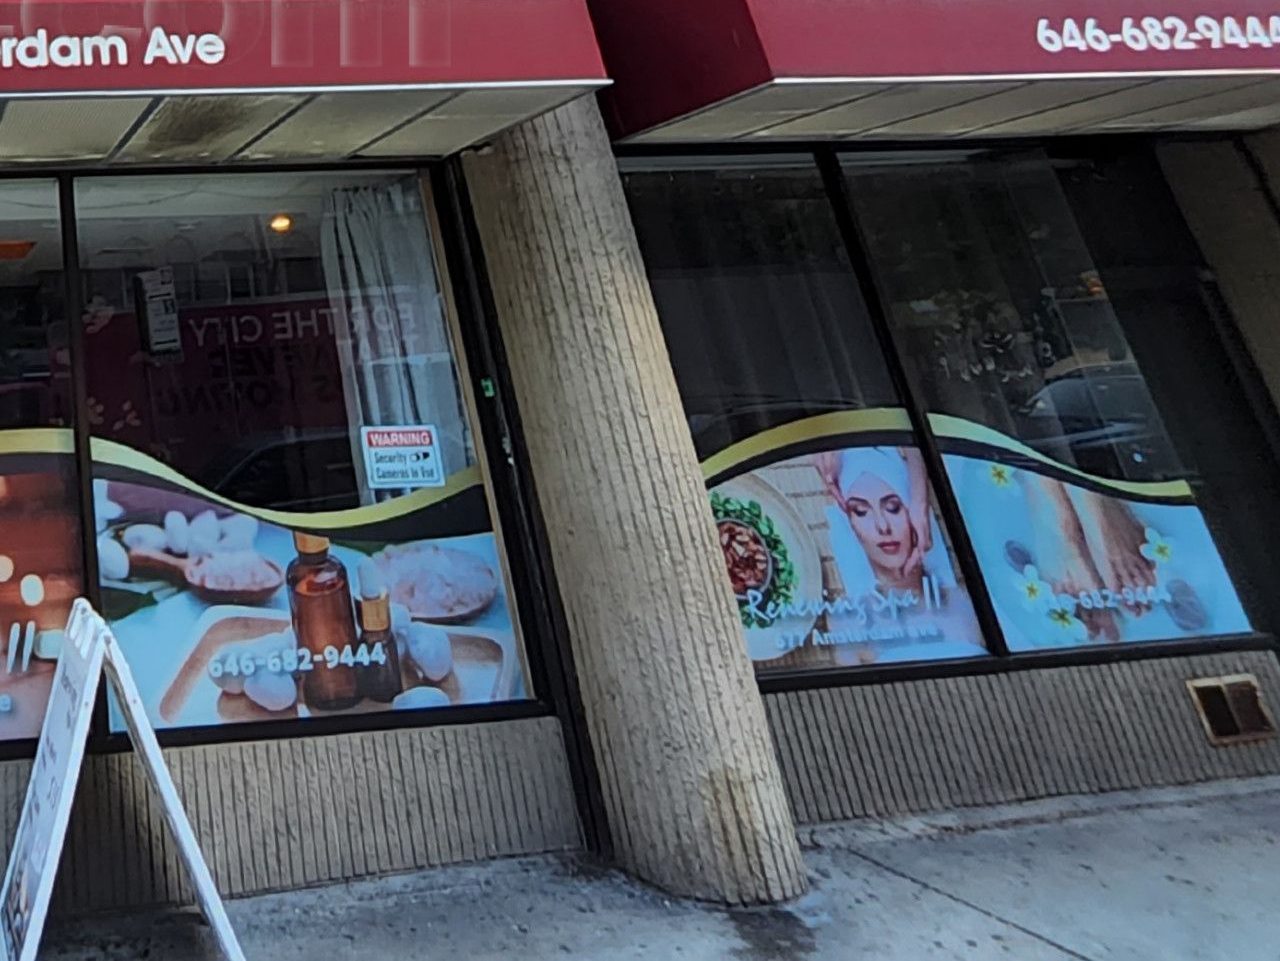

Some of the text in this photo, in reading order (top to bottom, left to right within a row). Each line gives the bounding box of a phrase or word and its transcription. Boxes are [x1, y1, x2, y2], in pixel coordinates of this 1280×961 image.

[143, 26, 227, 66] Ave
[370, 431, 430, 446] WARNING
[374, 451, 407, 465] Security
[375, 467, 410, 479] Cameras
[746, 589, 867, 626] Renewing
[872, 588, 919, 621] Spa
[207, 642, 387, 678] 646-682-9444
